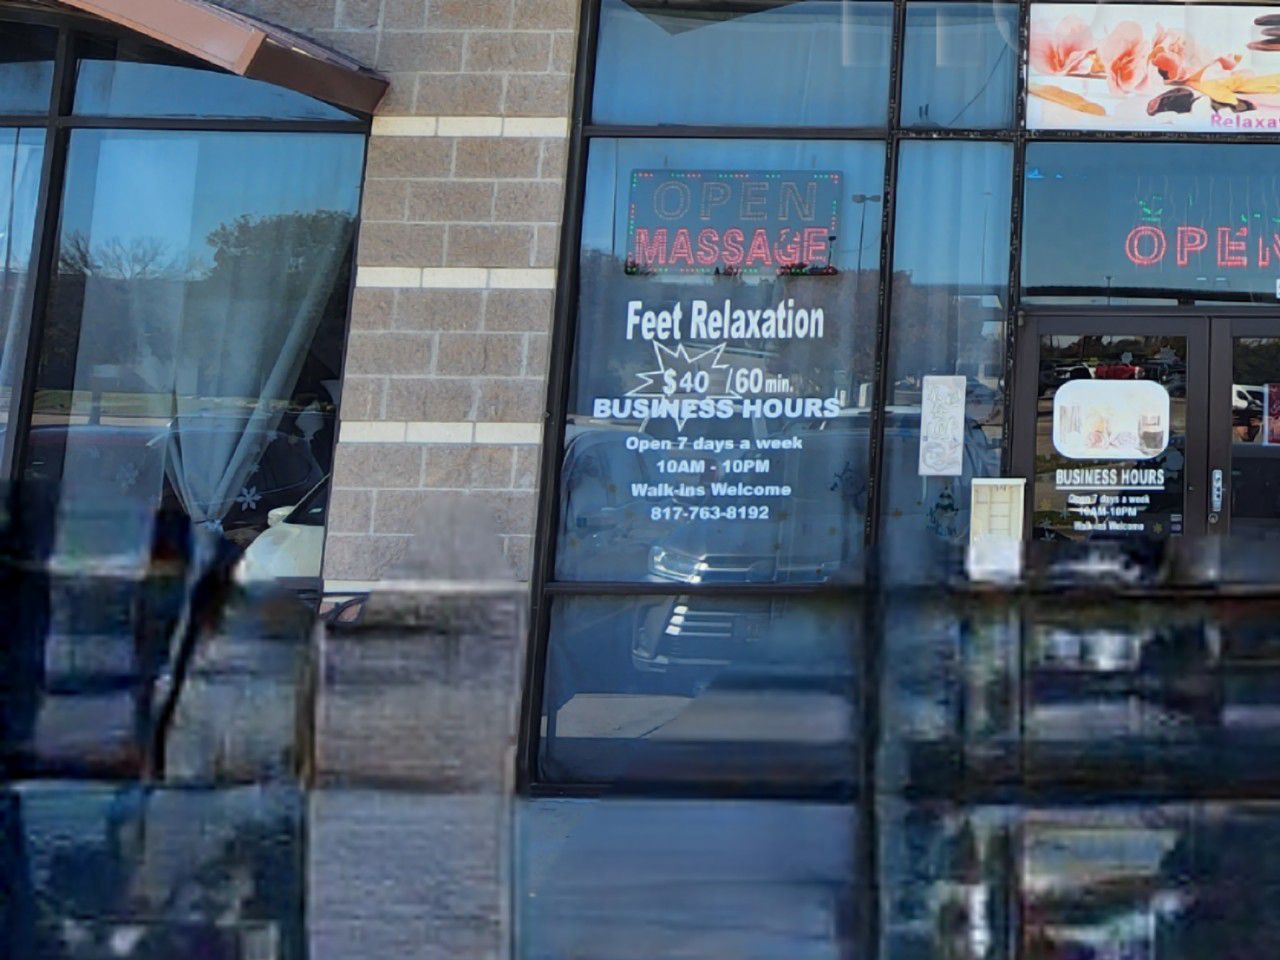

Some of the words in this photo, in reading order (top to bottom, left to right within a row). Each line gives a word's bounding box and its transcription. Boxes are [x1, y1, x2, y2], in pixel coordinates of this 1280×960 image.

[653, 181, 819, 221] OPEN
[634, 227, 830, 266] MASSAGE
[626, 300, 683, 340] Feet
[690, 299, 825, 340] Relaxation
[662, 368, 710, 397] $40
[593, 397, 735, 419] BUSINESS
[742, 397, 841, 419] HOURS
[625, 437, 672, 453] Open
[677, 437, 688, 450] 7
[693, 437, 734, 453] days
[740, 439, 751, 450] a
[756, 436, 804, 450] week
[656, 460, 706, 473] 10AM
[721, 460, 771, 473] 10PM
[1055, 468, 1118, 485] BUSINESS
[1121, 468, 1165, 485] HOURS
[631, 483, 706, 497] Walk-ins
[711, 482, 793, 497] Welcome
[650, 506, 770, 521] 817-763-8192
